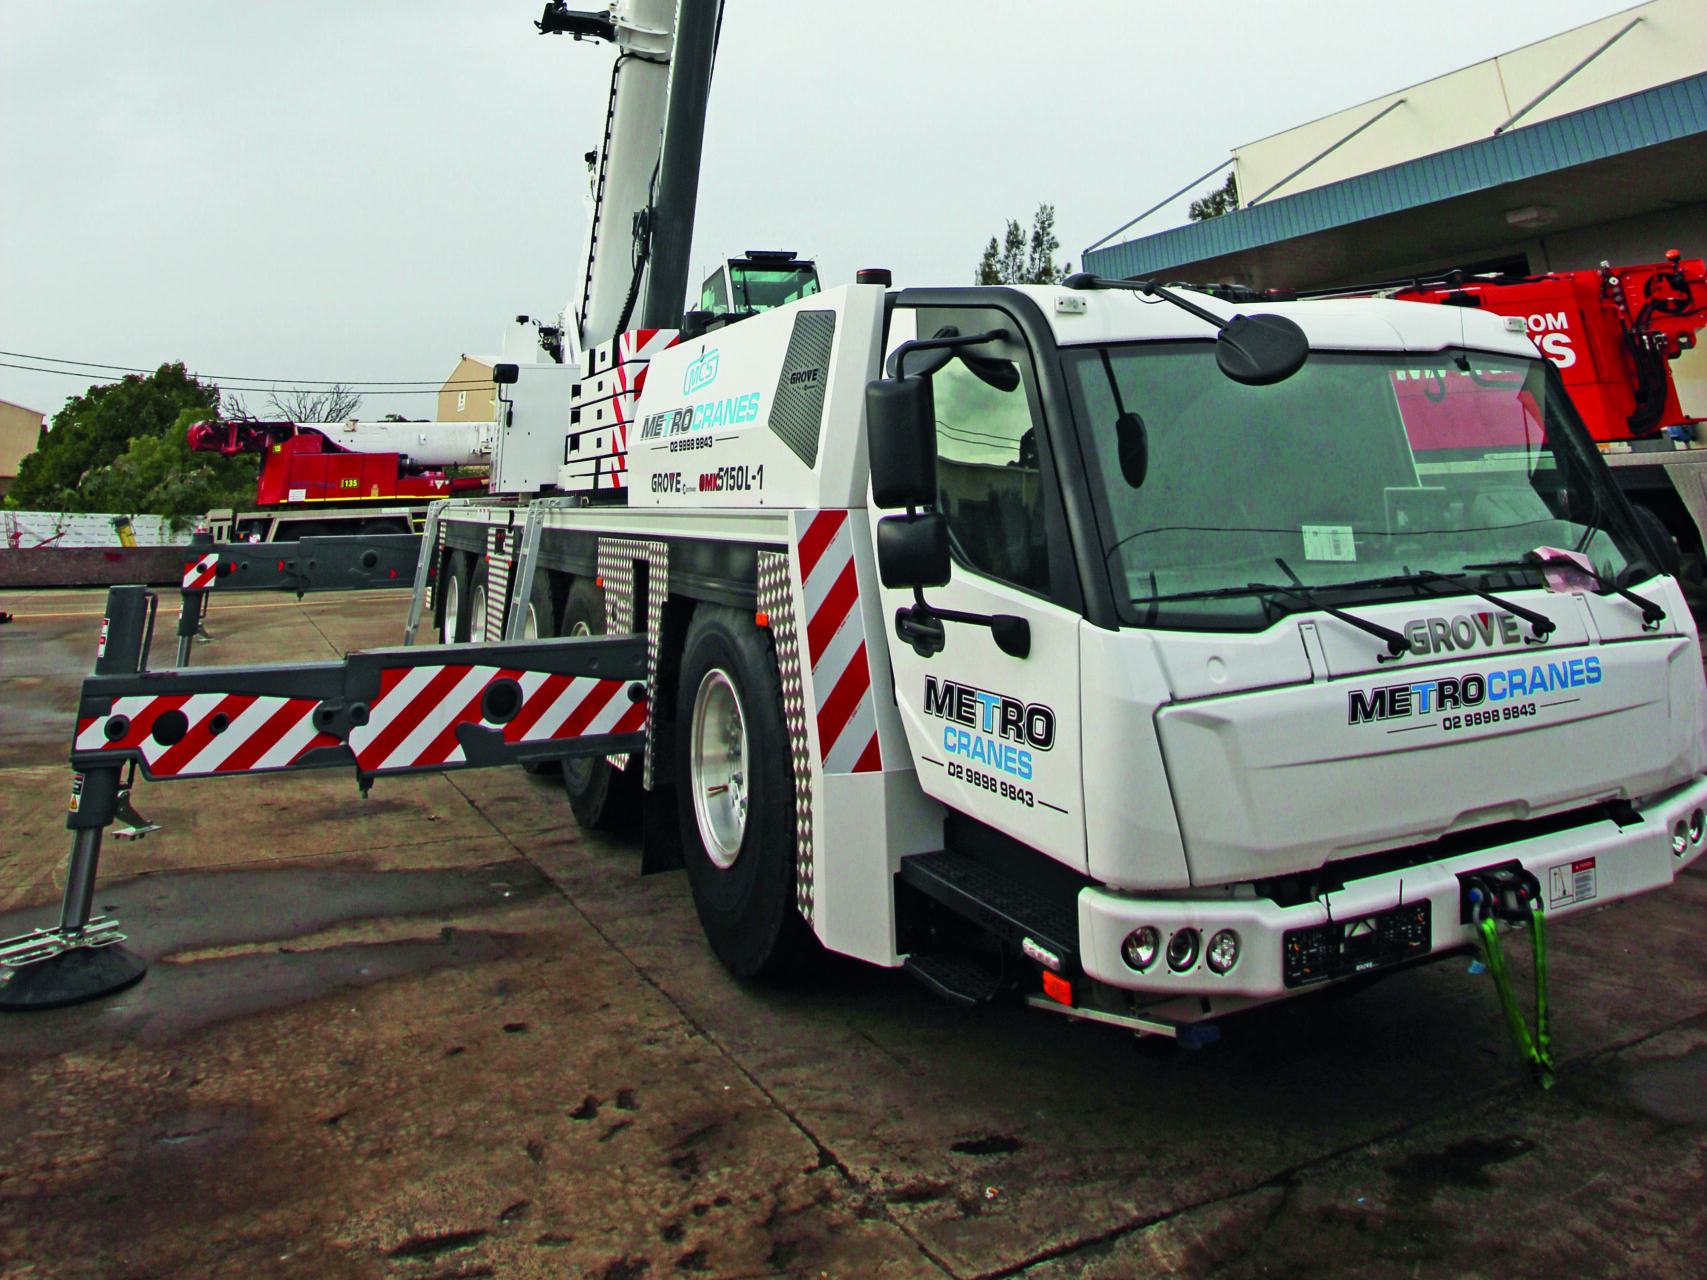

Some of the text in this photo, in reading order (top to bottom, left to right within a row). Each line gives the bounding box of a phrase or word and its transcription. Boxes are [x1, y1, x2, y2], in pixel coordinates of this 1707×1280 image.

[790, 368, 819, 385] GROVE
[640, 392, 760, 442] METRO CRANES
[669, 435, 713, 453] 02 9898 9843
[651, 471, 682, 493] GROVE
[1404, 612, 1521, 656] GROVE
[923, 674, 1057, 752] METRO
[1348, 656, 1603, 726] METRO CRANES
[1442, 703, 1537, 731] 02 9898 9843
[943, 726, 1033, 781] CRANES
[947, 761, 1035, 808] 02 9898 9843
